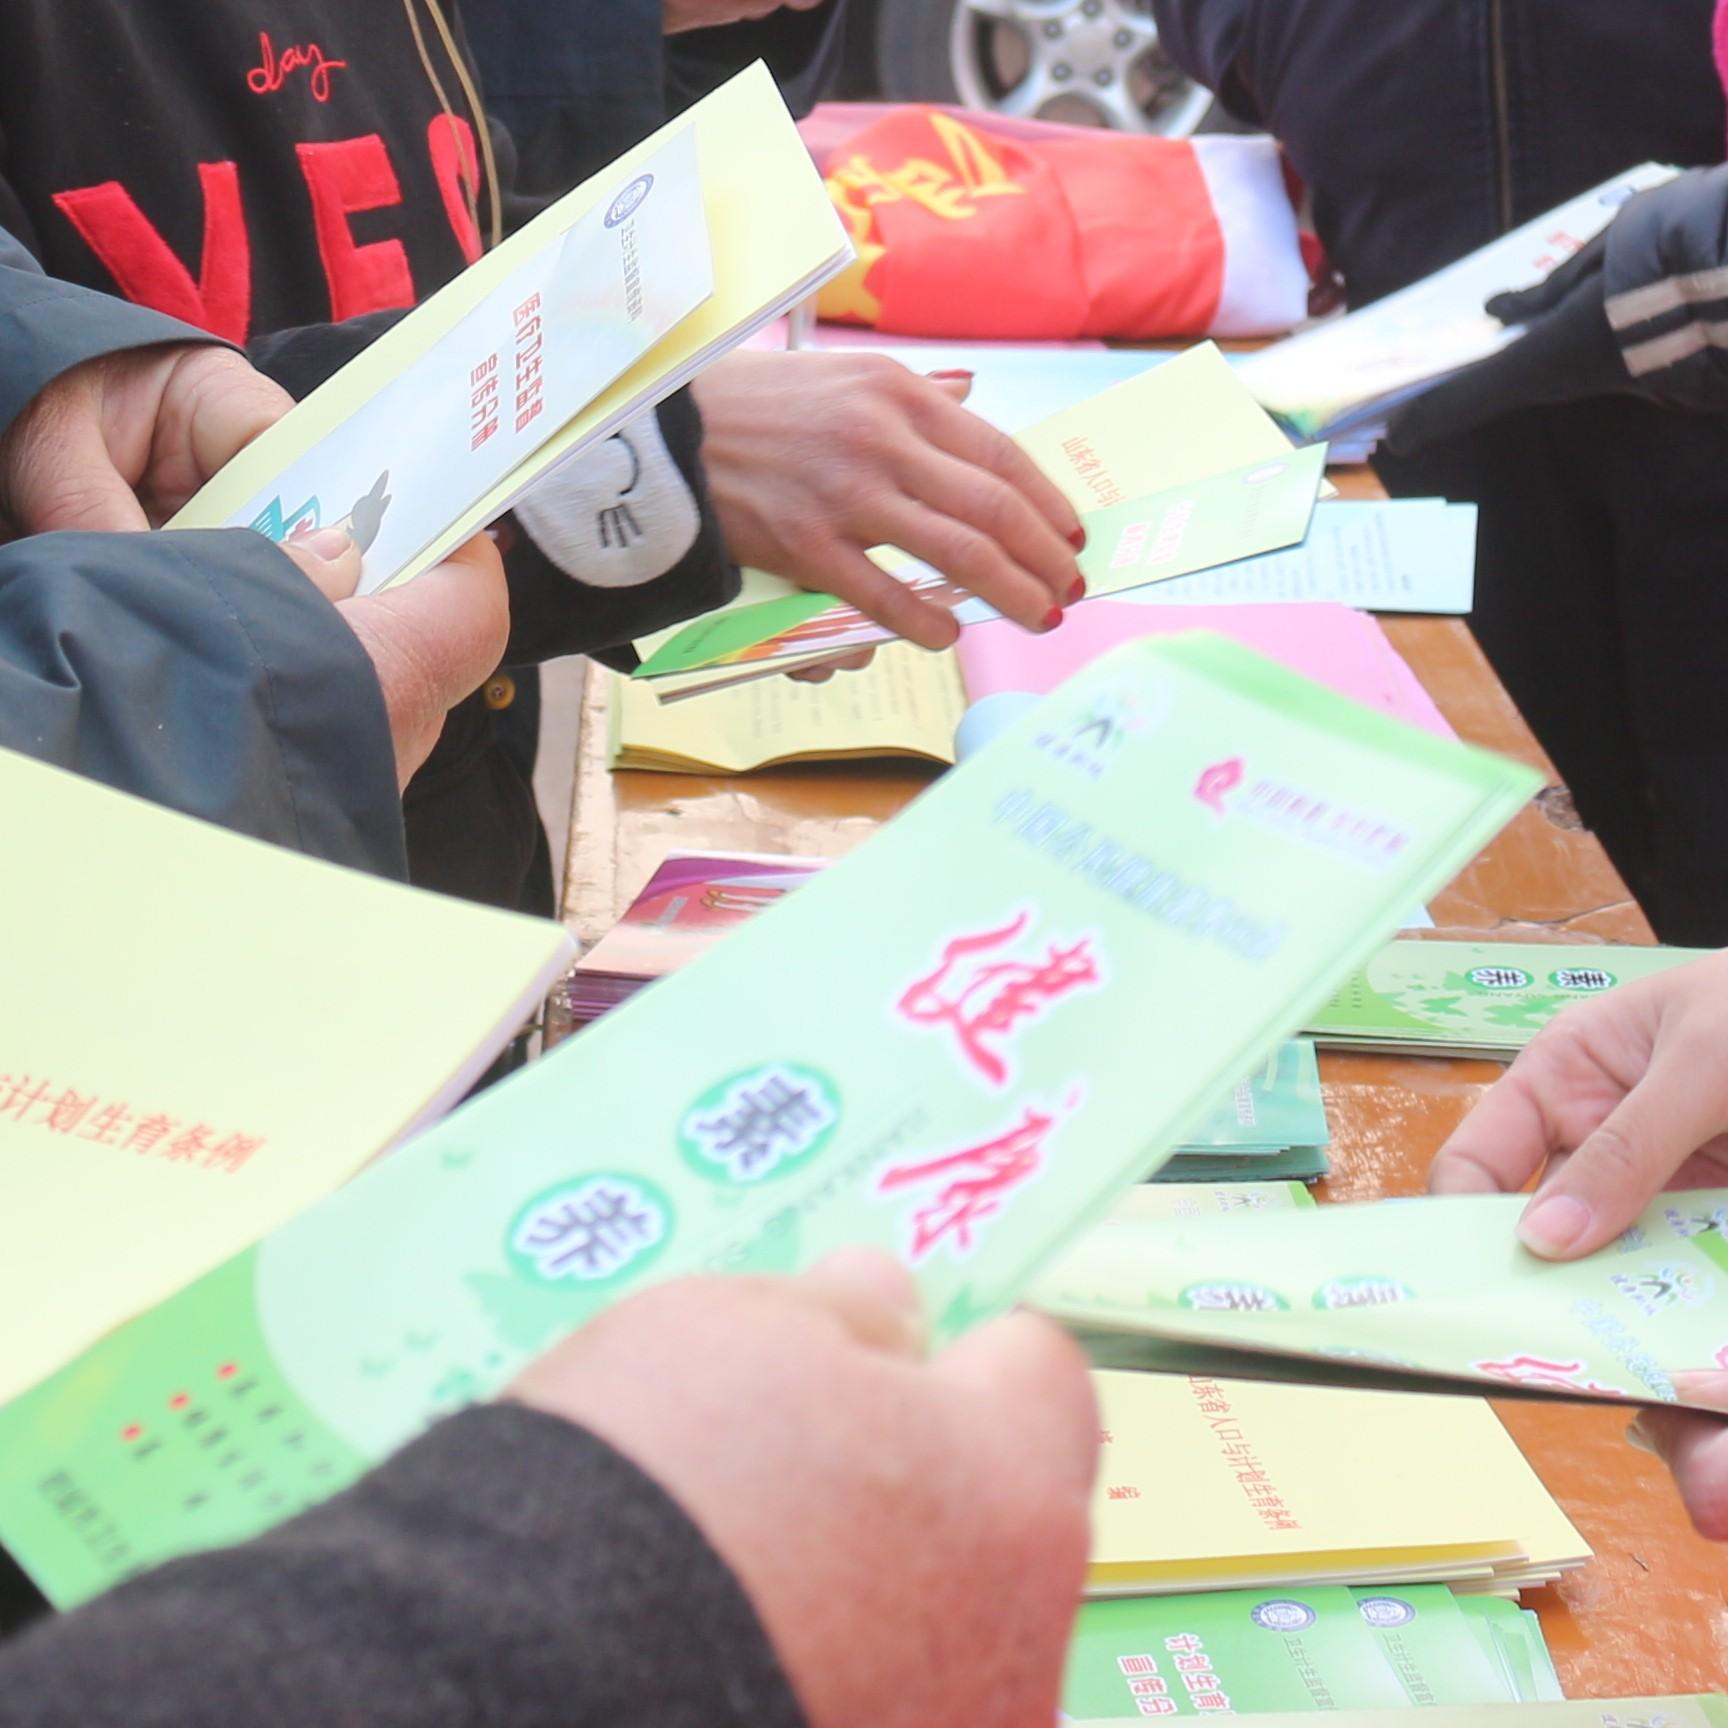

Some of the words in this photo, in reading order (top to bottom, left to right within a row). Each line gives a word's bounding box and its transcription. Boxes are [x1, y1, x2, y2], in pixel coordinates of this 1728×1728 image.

[247, 32, 347, 103] day
[470, 352, 499, 452] 宣传分册
[512, 291, 544, 434] 医疗卫生监督
[1165, 1633, 1234, 1713] 计划生育
